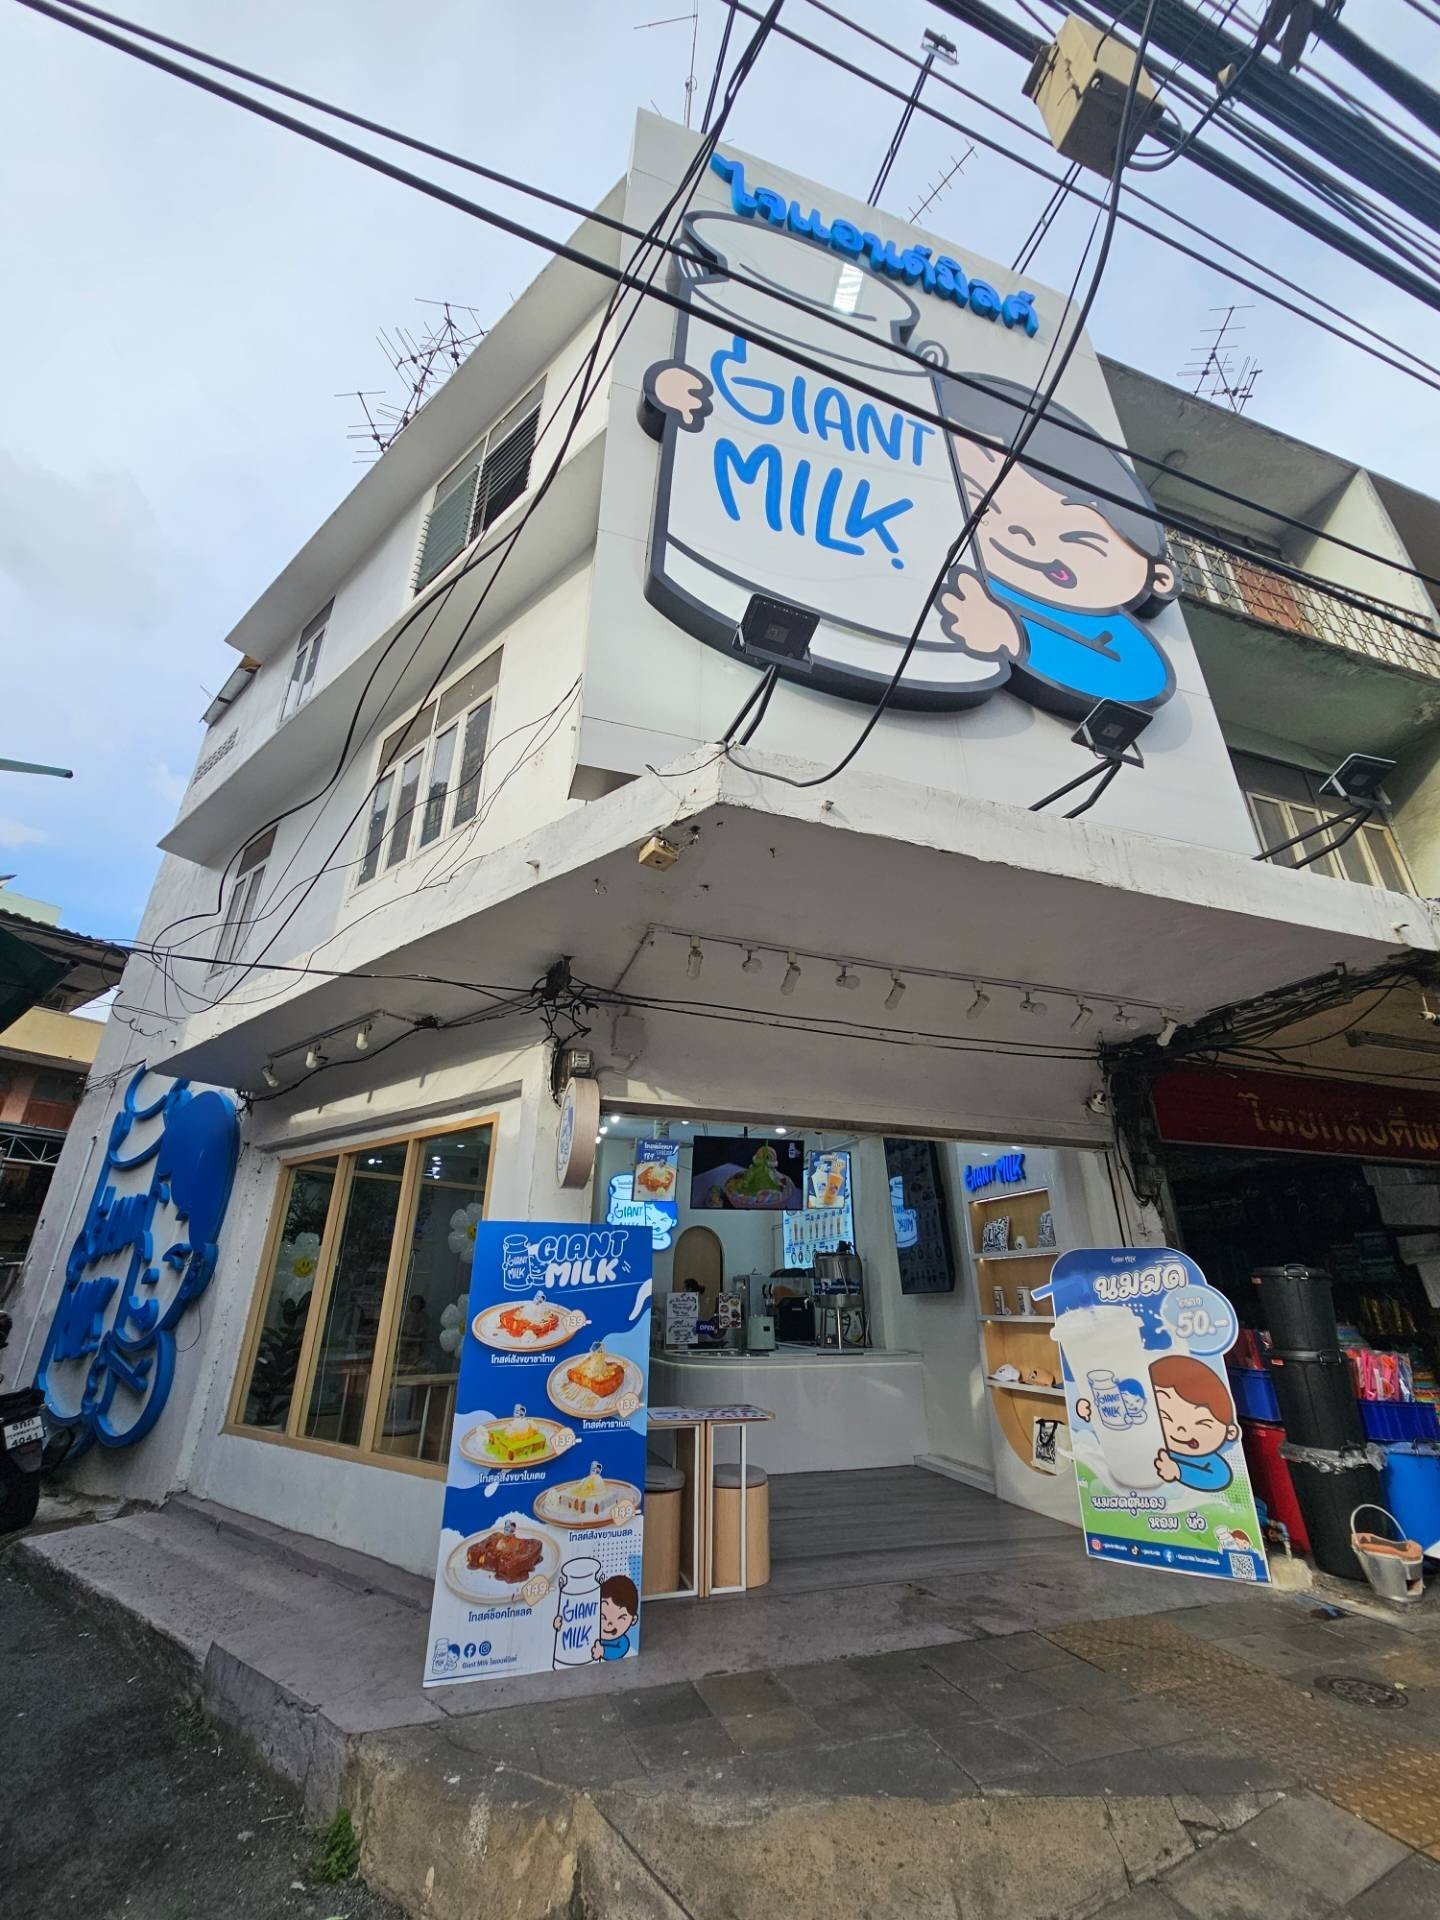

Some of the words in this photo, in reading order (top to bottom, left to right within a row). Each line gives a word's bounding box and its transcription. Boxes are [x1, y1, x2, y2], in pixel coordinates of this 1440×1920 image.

[711, 336, 936, 466] GIANT
[614, 1203, 643, 1218] GIANT
[537, 1230, 629, 1264] GIANT
[545, 1258, 619, 1288] MILK
[1093, 1263, 1188, 1300] นมสด
[1102, 1406, 1121, 1417] MILK
[562, 1600, 599, 1622] GIANT
